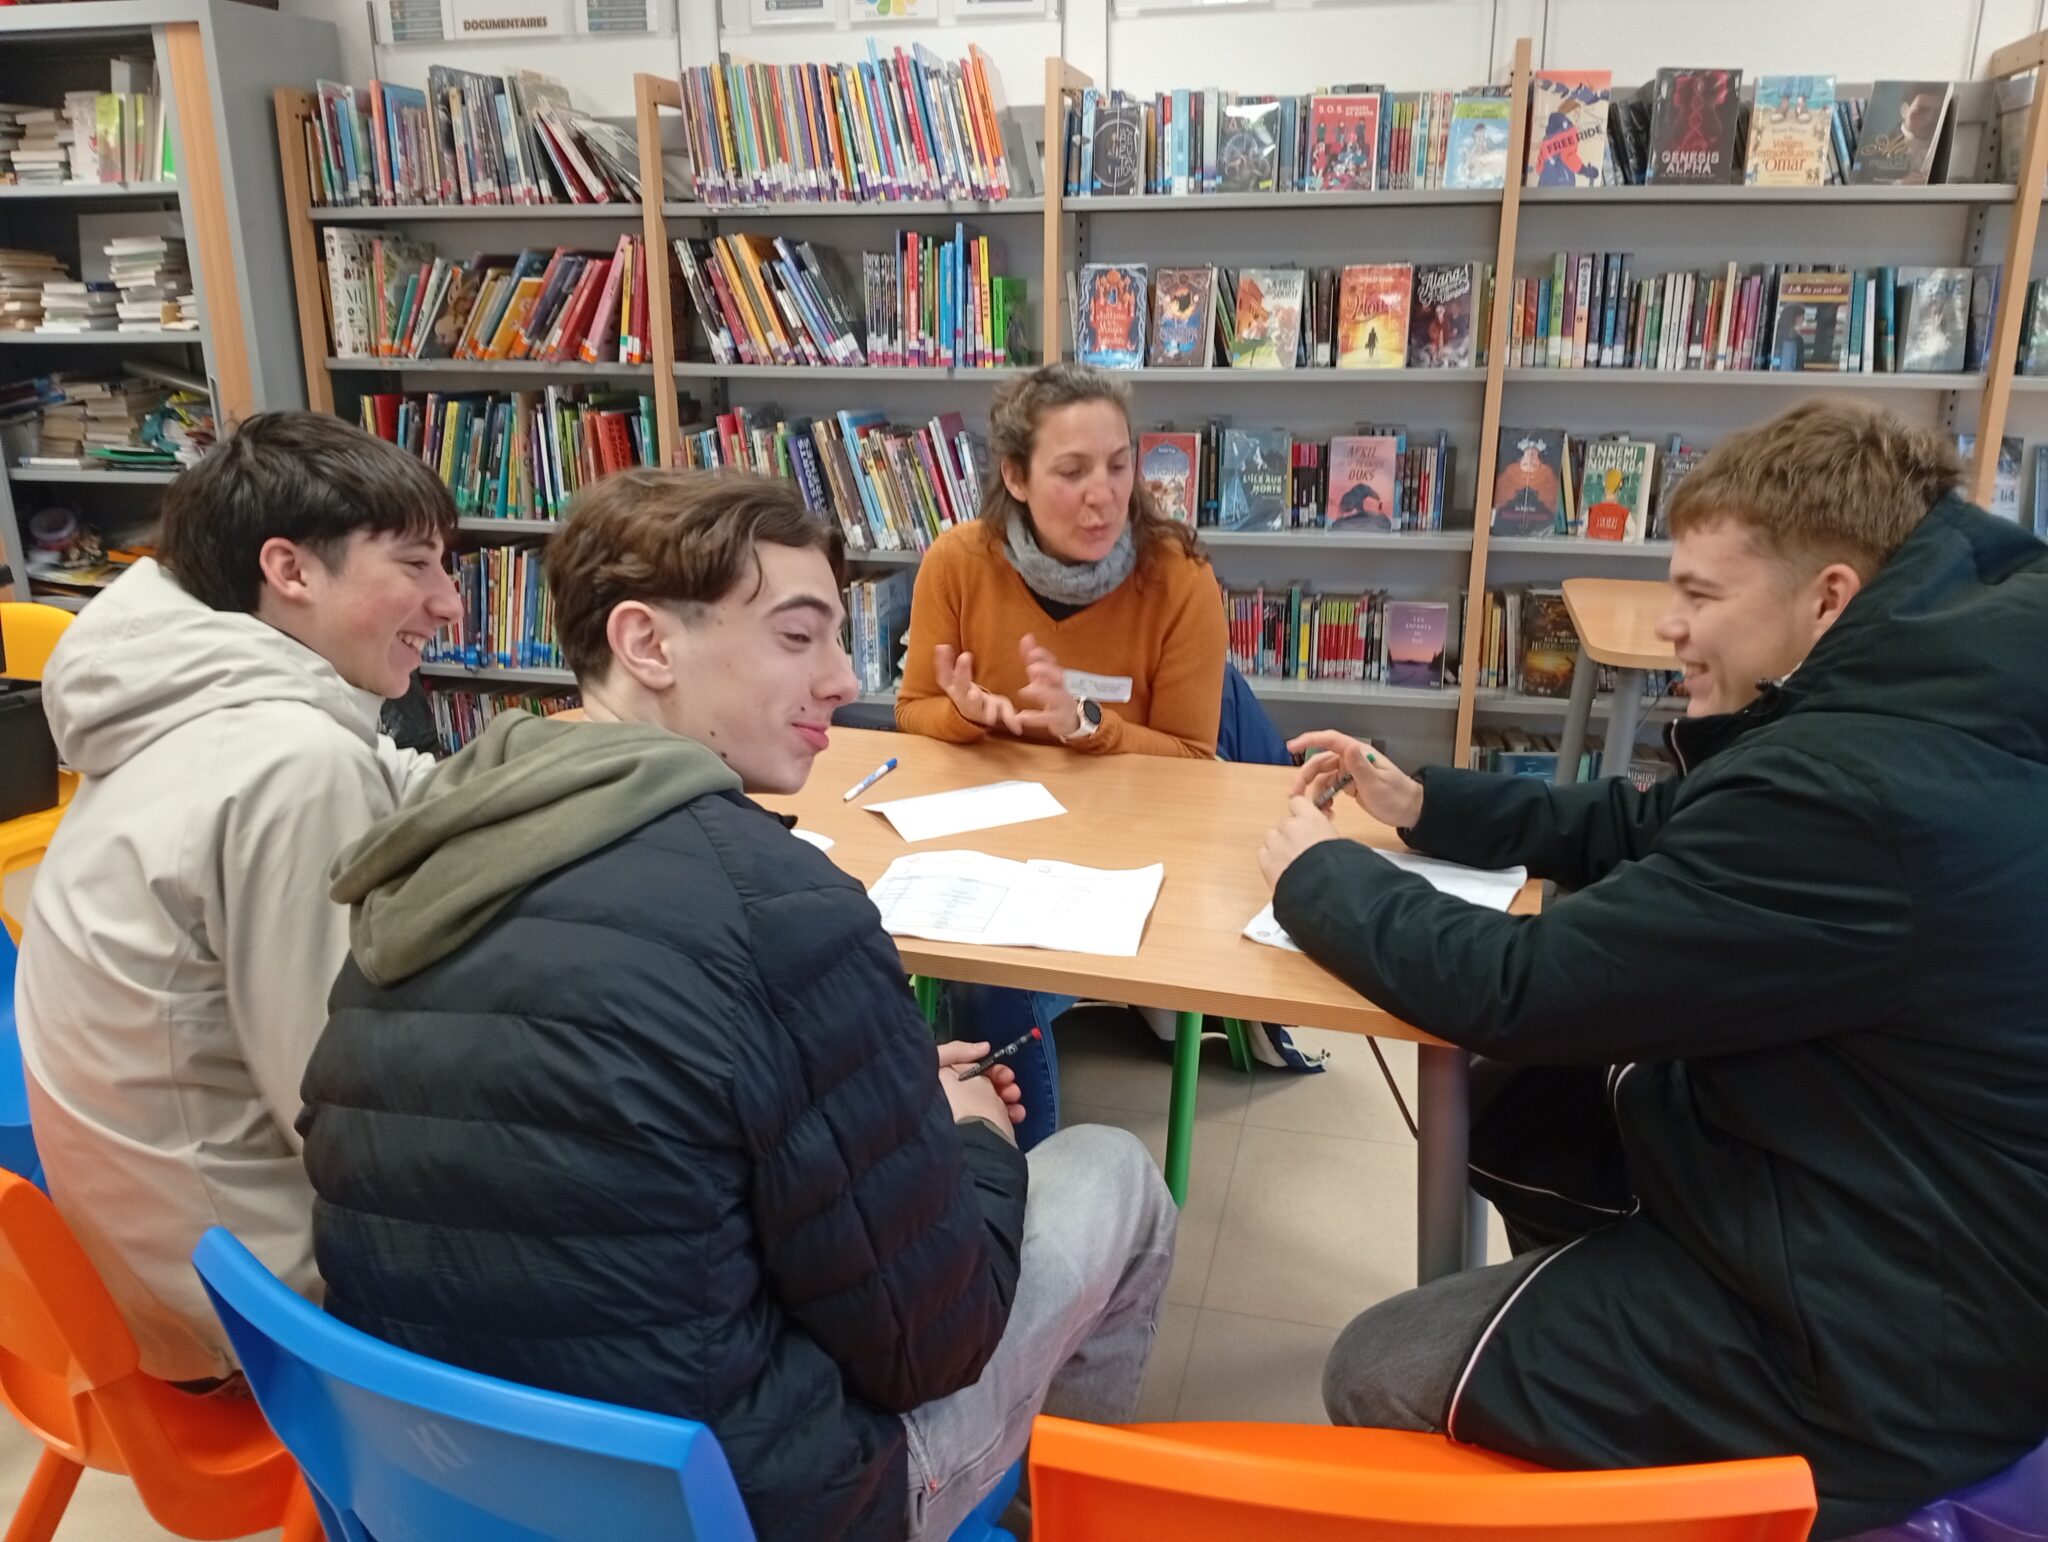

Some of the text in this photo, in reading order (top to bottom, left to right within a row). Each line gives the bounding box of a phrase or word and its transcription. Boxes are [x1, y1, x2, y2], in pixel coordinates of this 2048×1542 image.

[463, 16, 548, 31] DOCUMENTAIRES
[1661, 150, 1720, 164] GENESIS
[1665, 162, 1712, 175] ALPHA
[1588, 444, 1638, 461] ENNEMI
[1251, 484, 1282, 496] MORTS
